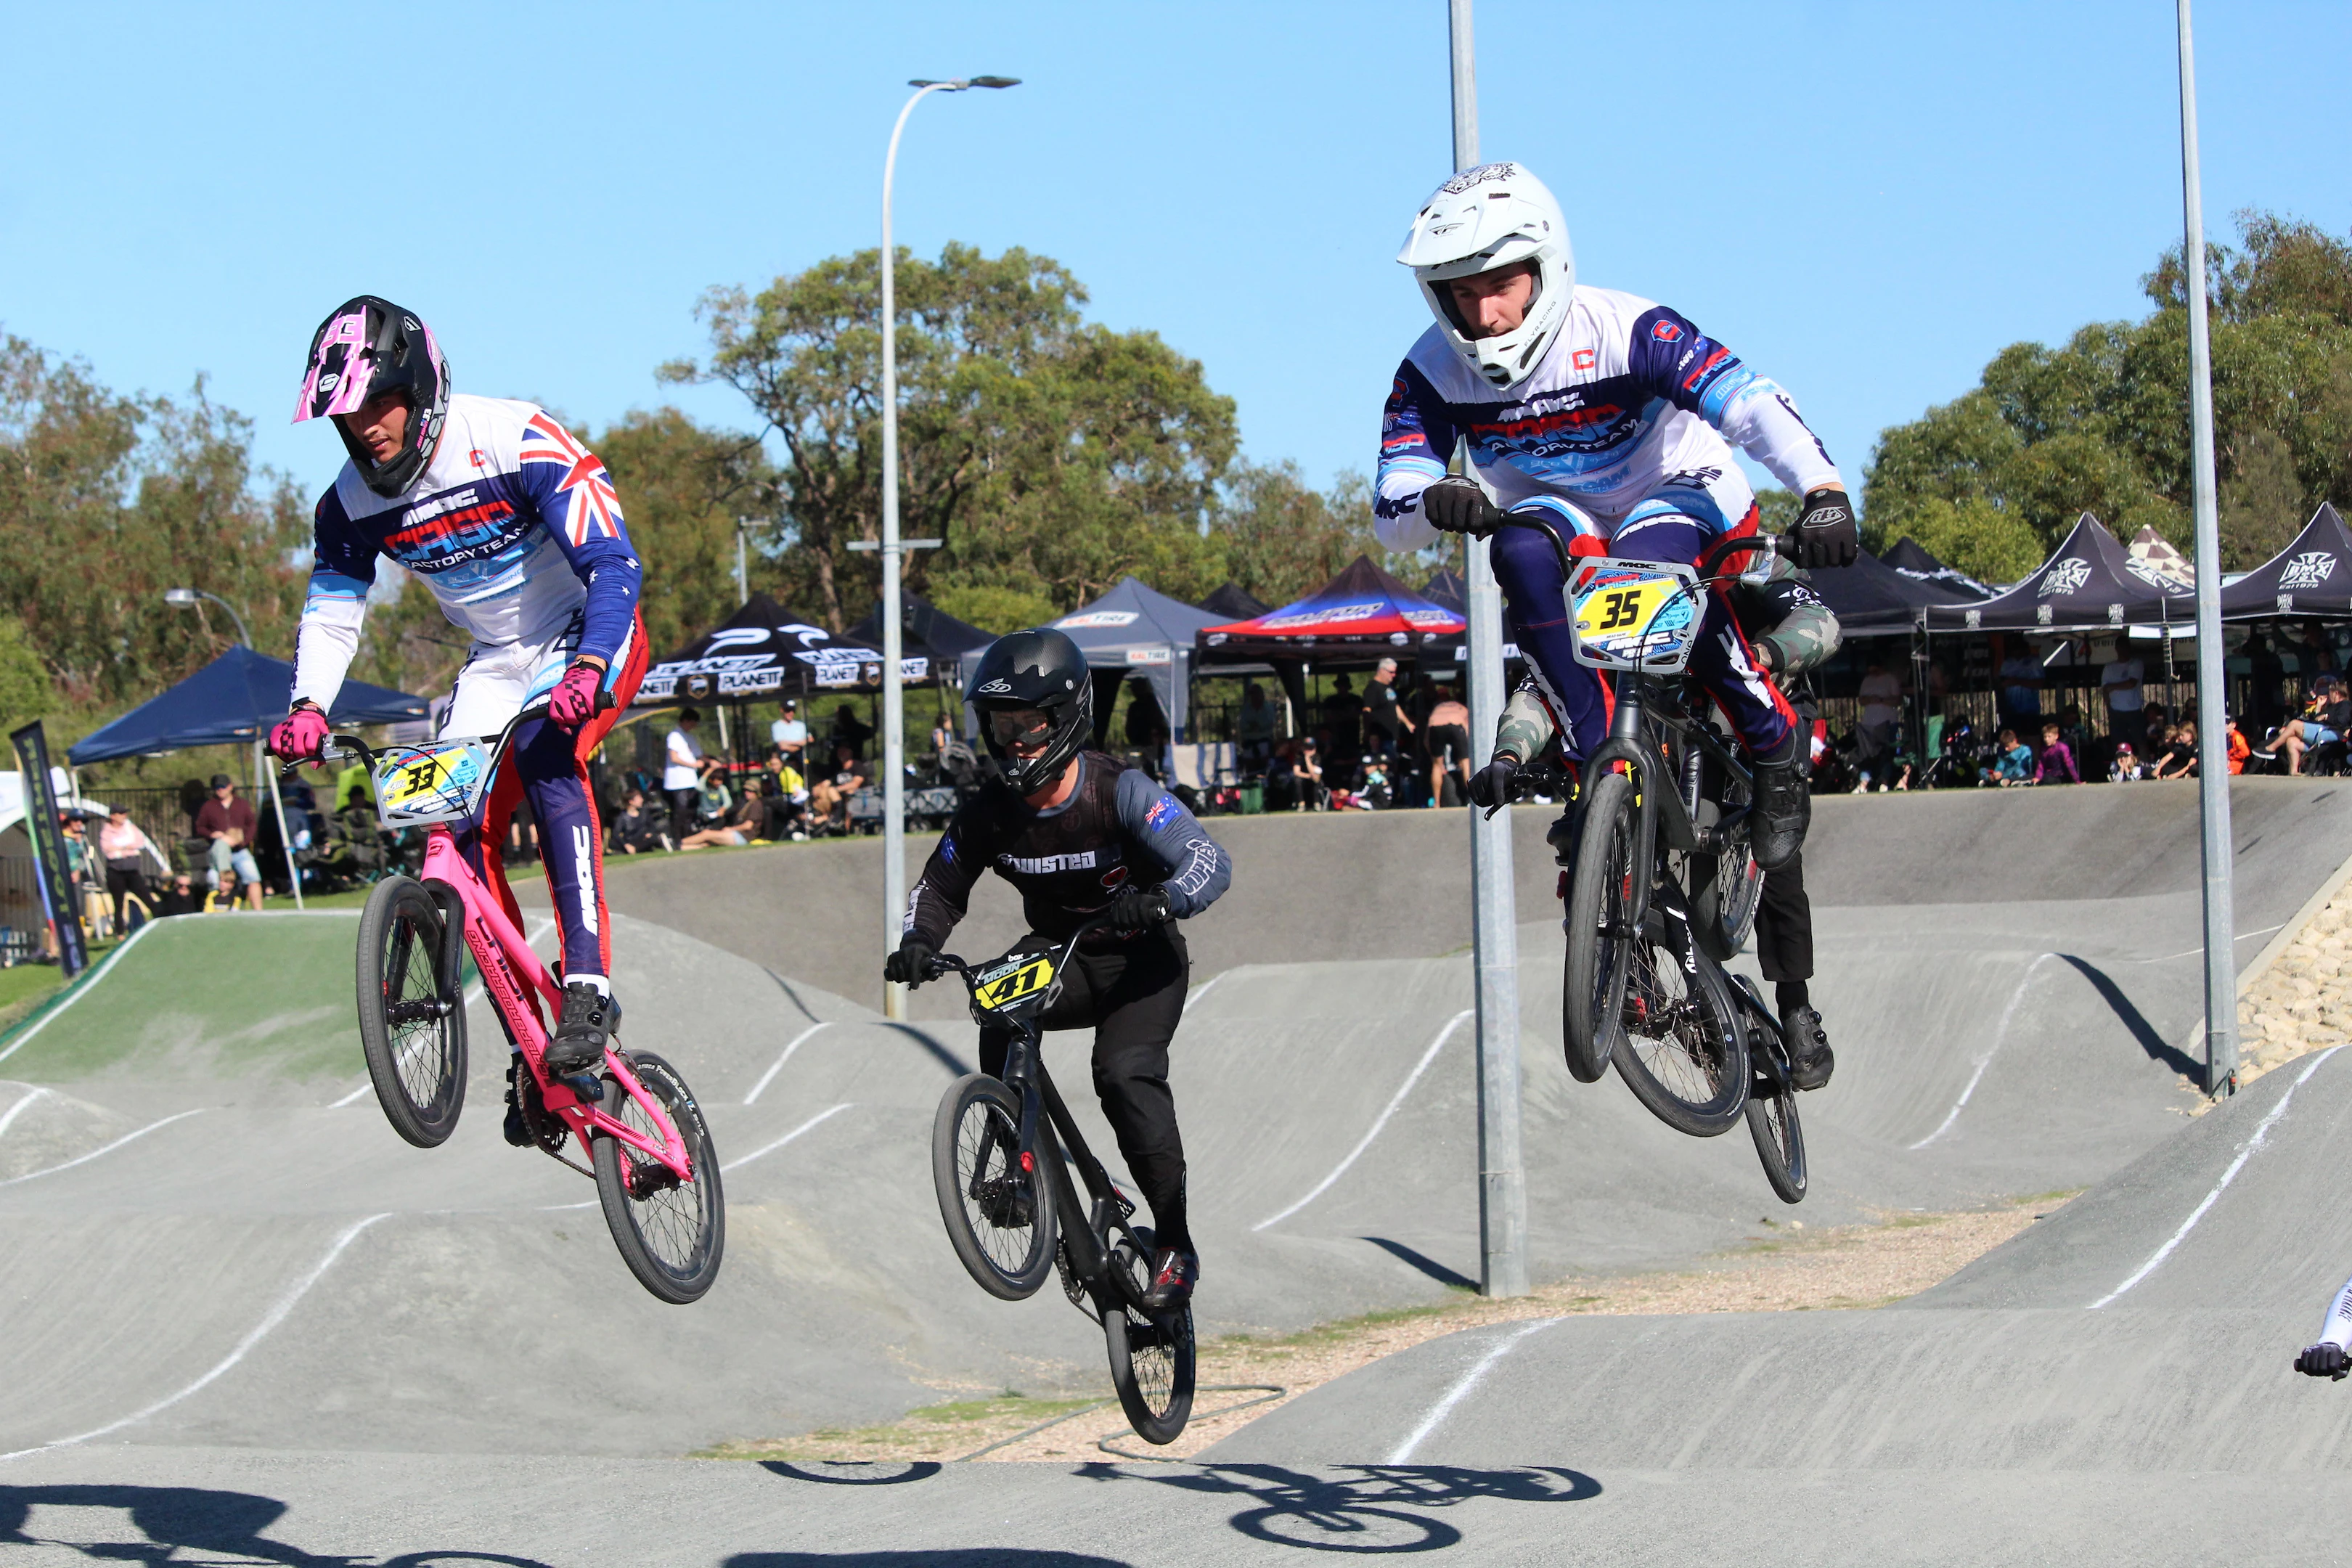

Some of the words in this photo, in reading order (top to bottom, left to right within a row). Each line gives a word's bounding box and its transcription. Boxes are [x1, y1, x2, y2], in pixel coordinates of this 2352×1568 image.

[319, 314, 367, 352] 33
[478, 521, 528, 554] TEAM
[1599, 589, 1641, 630] 35
[403, 761, 437, 797] 33
[572, 824, 599, 939] MAC
[1008, 952, 1024, 963] box
[989, 963, 1040, 1002] 41
